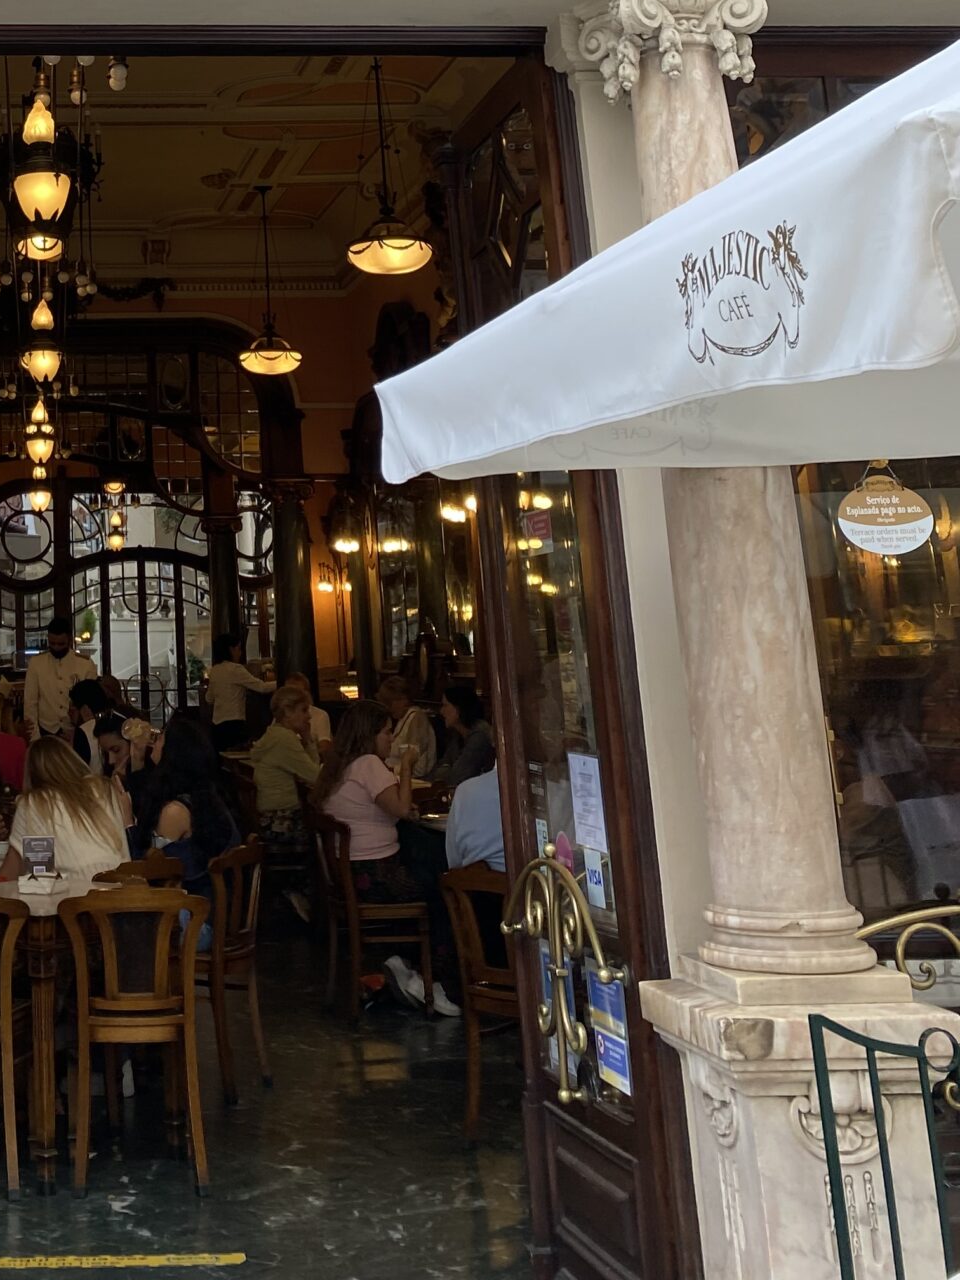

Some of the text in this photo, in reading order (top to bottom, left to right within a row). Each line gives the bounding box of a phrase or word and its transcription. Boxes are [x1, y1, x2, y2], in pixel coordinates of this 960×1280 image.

[695, 229, 771, 298] MAJESTIC
[718, 291, 754, 322] CAFÉ
[866, 495, 900, 506] Serviço de
[846, 506, 880, 518] Esplanada
[881, 507, 897, 517] pago
[851, 528, 875, 536] Terrace
[877, 527, 899, 535] orders
[586, 868, 603, 887] VISA
